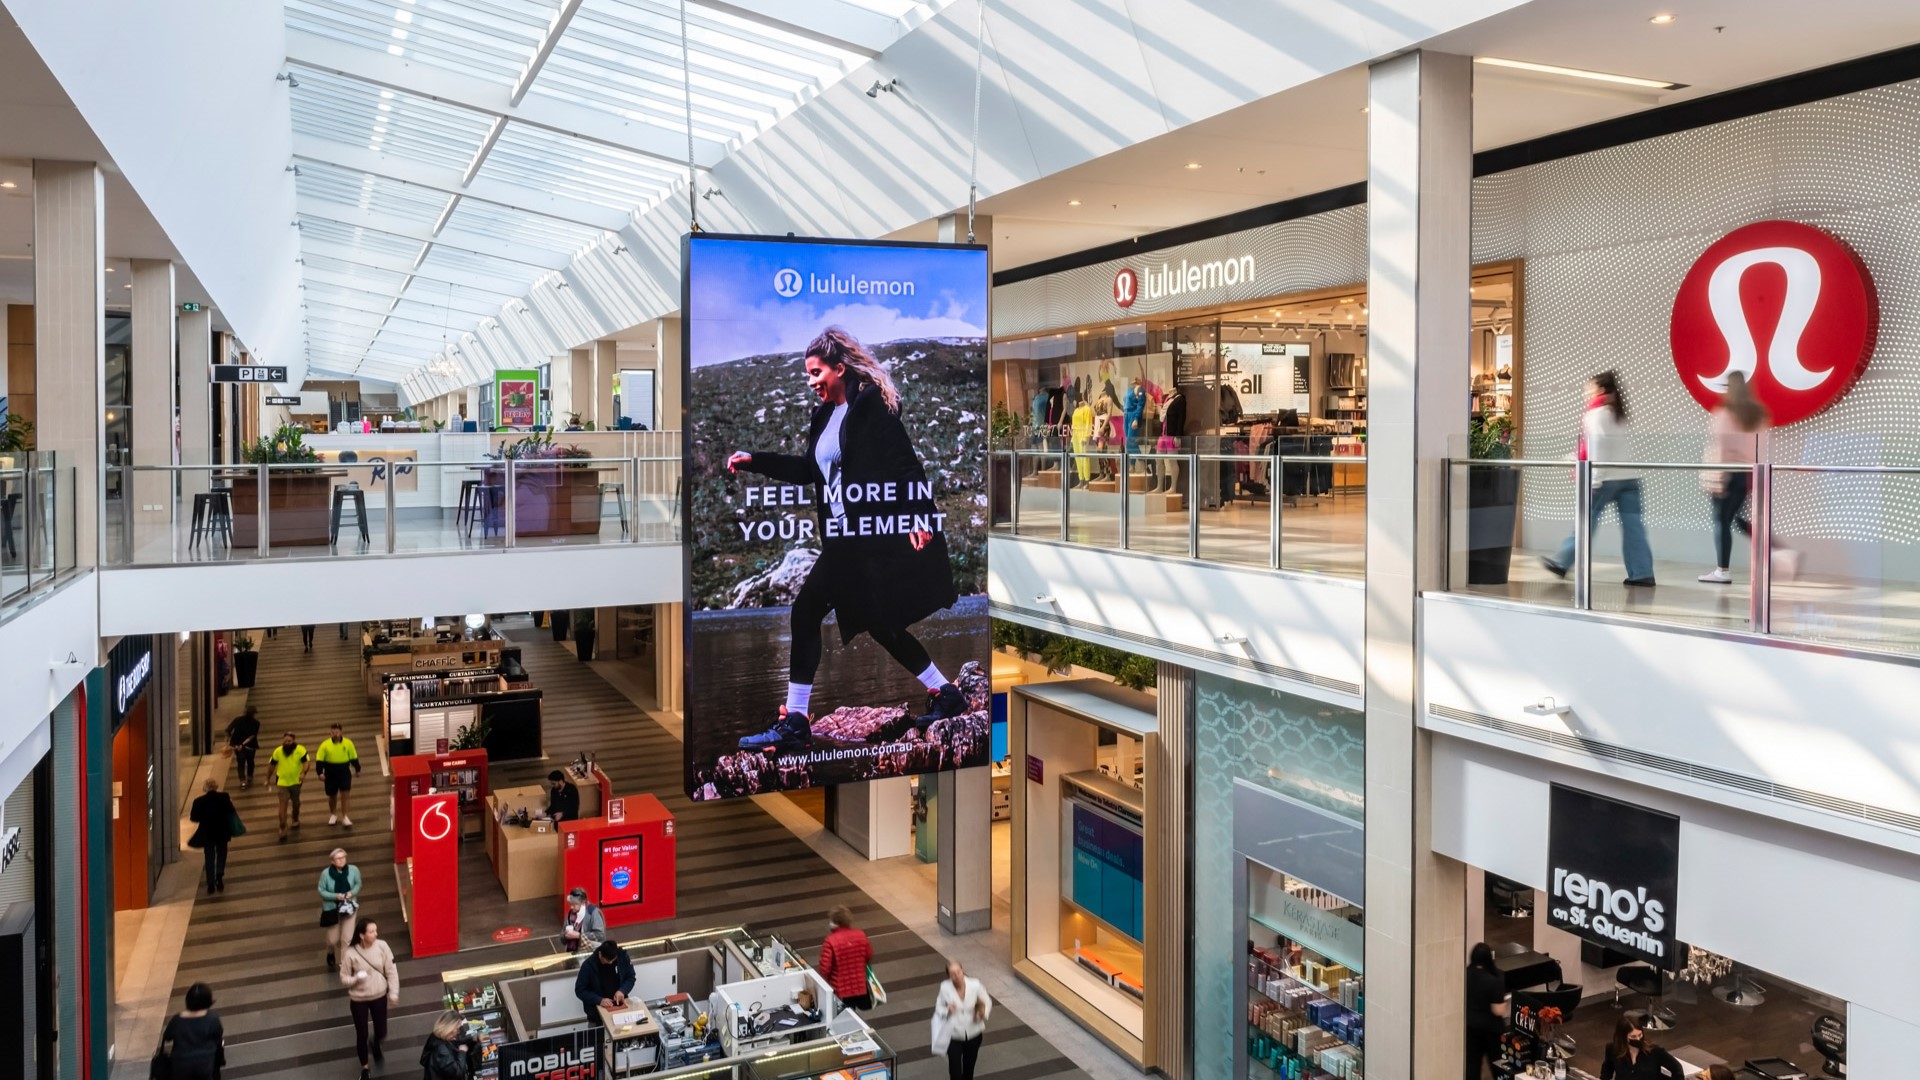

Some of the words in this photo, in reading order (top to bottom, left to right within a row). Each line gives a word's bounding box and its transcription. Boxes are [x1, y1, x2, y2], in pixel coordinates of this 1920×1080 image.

[810, 272, 915, 296] lululemon
[1144, 254, 1255, 299] lululemon
[745, 485, 811, 507] FEEL
[823, 481, 897, 504] MORE
[907, 480, 933, 500] IN
[739, 518, 814, 542] YOUR
[825, 512, 947, 538] ELEMENT
[778, 742, 913, 766] www.lululemon.com.au
[621, 844, 638, 852] Value
[1553, 867, 1665, 932] reno's
[1552, 907, 1568, 921] on
[1569, 905, 1590, 929] St.
[1592, 914, 1664, 957] Quentin
[1515, 1011, 1536, 1032] CREW
